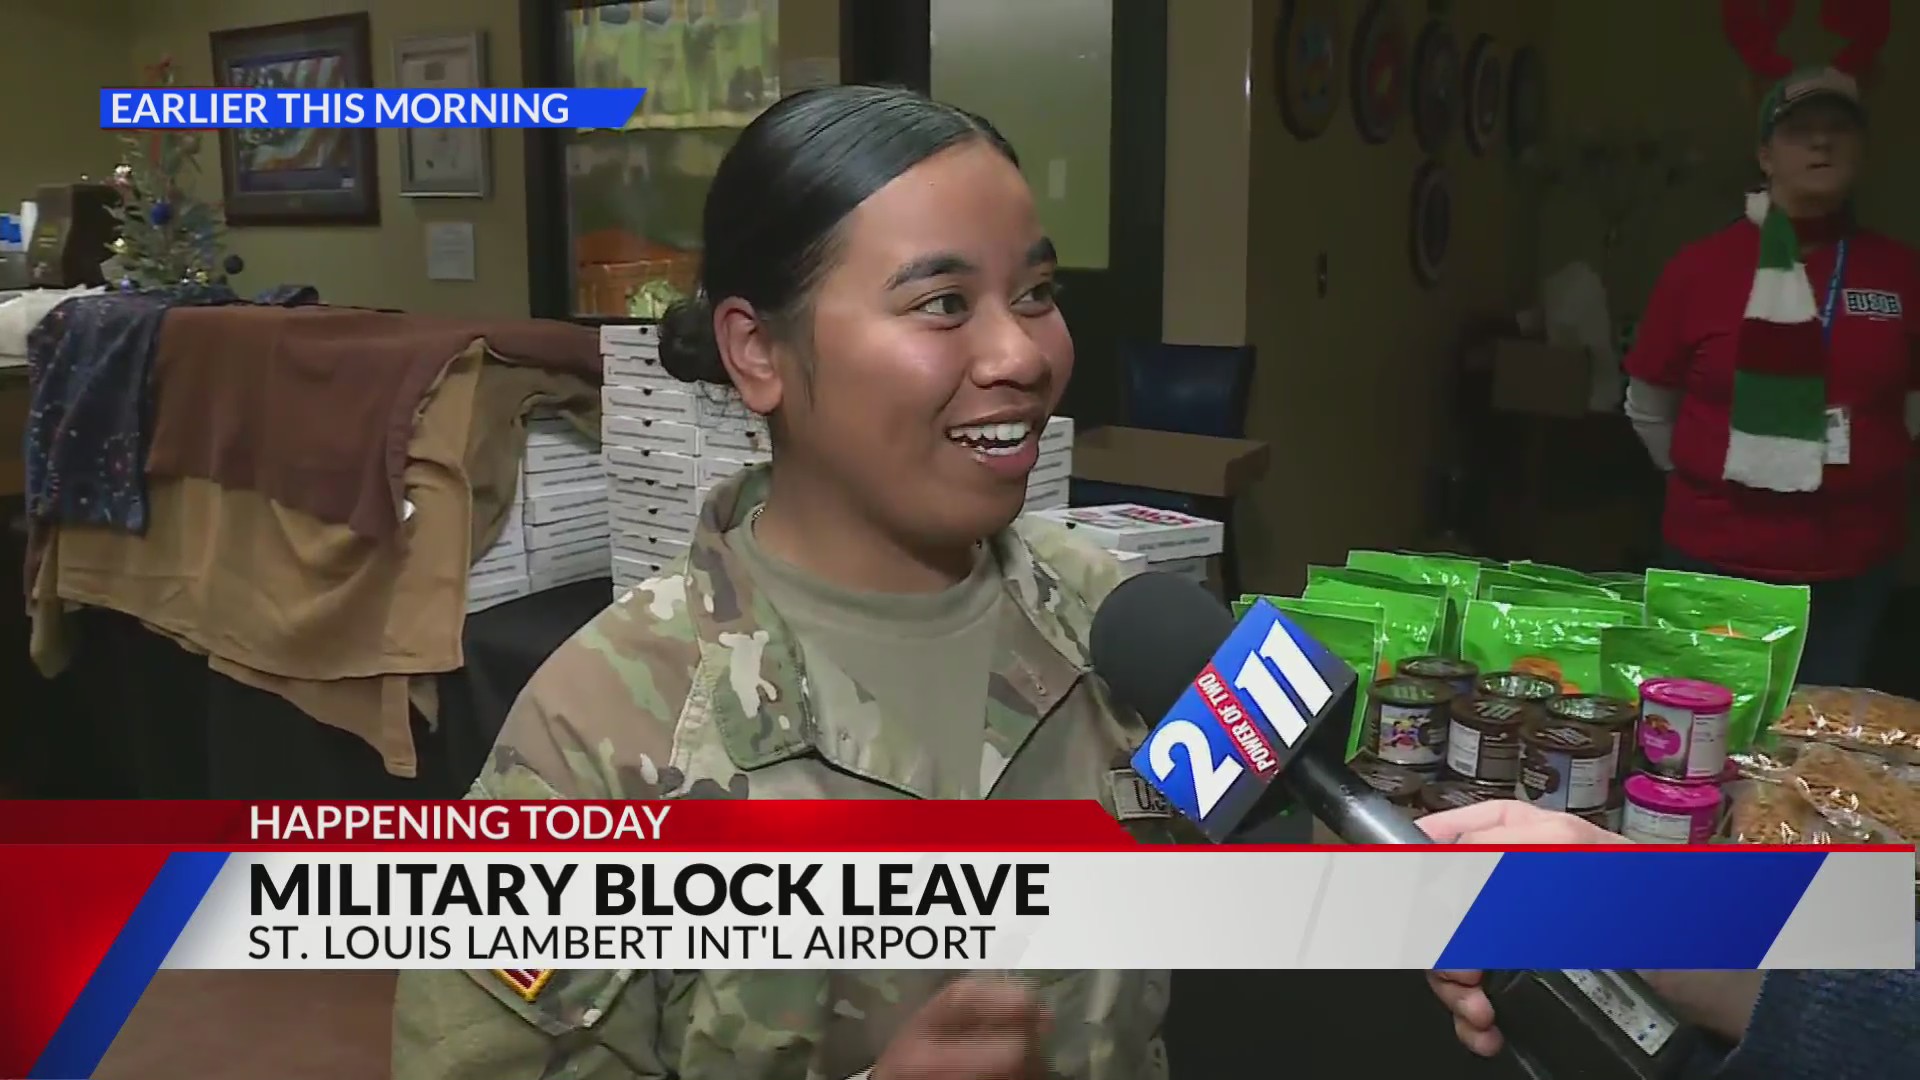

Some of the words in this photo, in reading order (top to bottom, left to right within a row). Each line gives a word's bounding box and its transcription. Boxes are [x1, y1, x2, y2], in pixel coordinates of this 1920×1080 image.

[1198, 672, 1229, 708] TWO
[1235, 619, 1333, 748] 11
[1217, 704, 1242, 725] OF
[1149, 719, 1244, 821] 2
[1231, 720, 1276, 772] POWER
